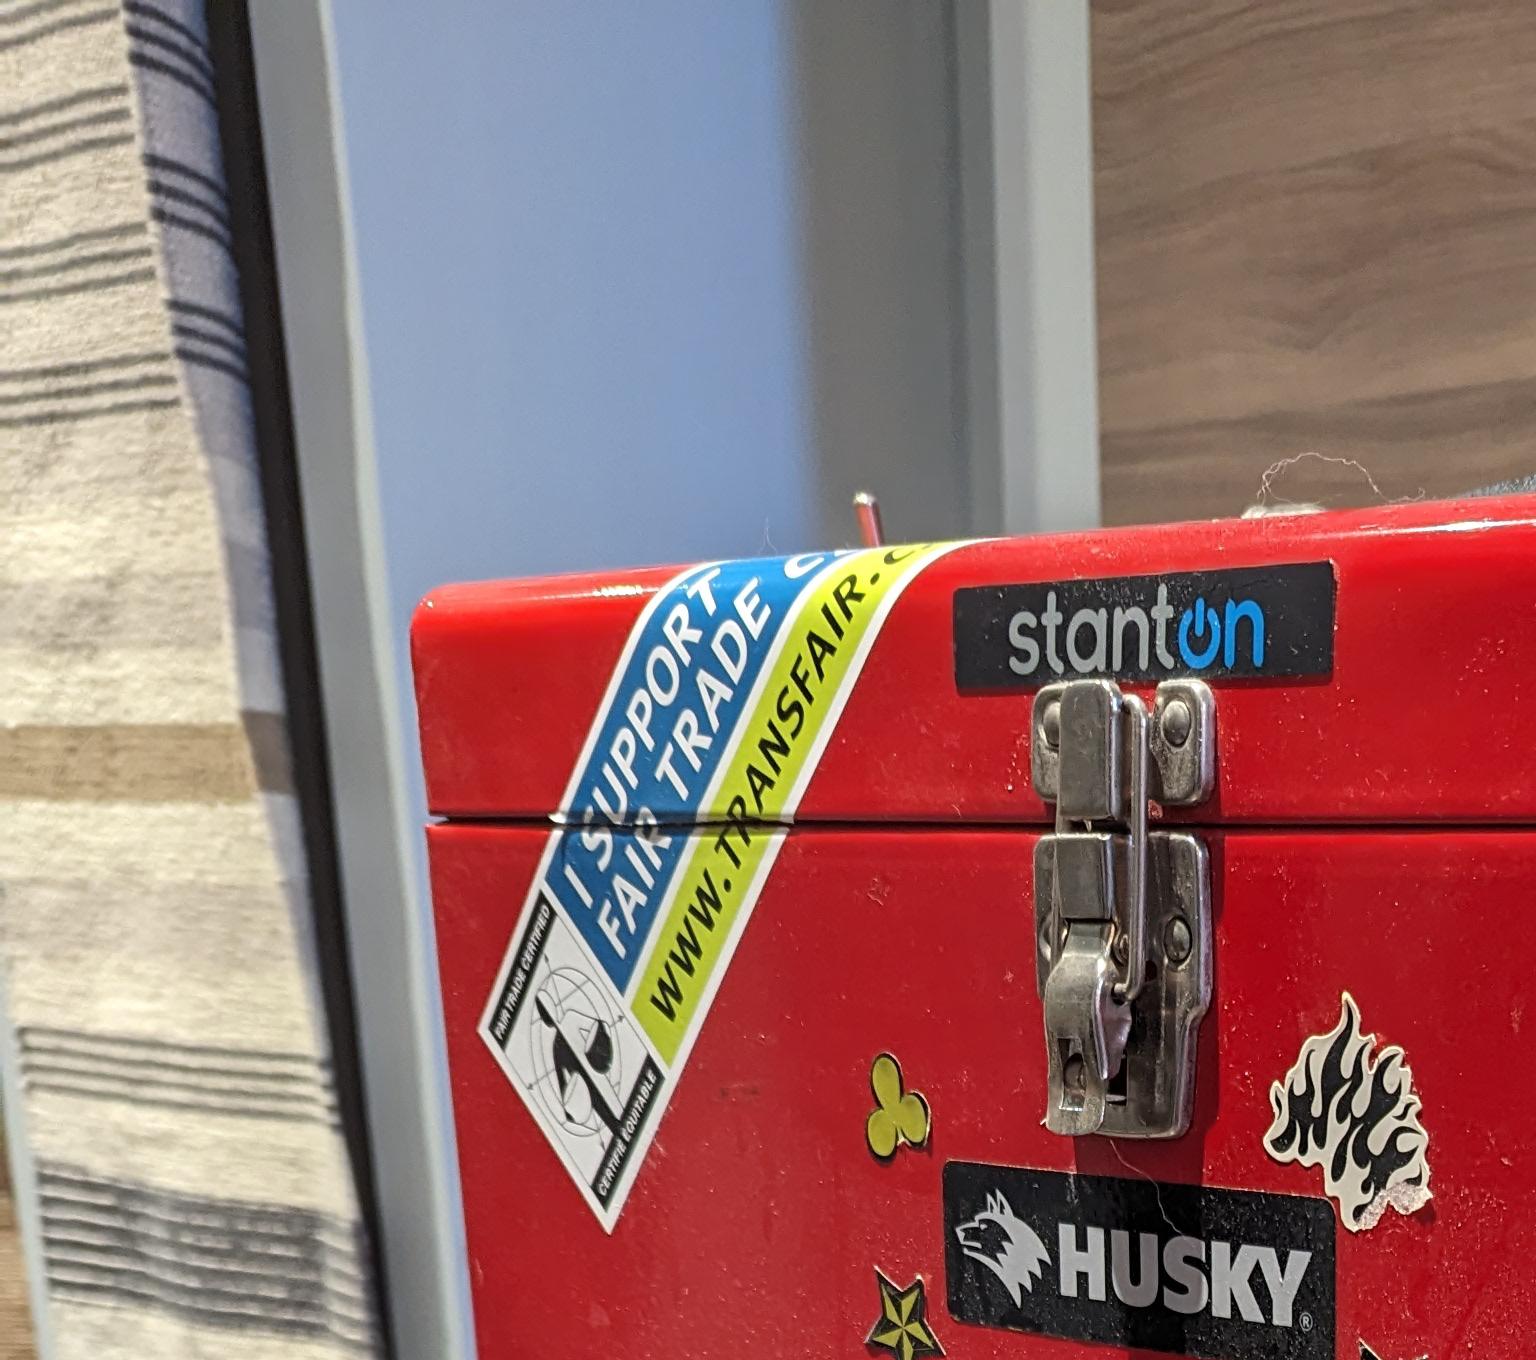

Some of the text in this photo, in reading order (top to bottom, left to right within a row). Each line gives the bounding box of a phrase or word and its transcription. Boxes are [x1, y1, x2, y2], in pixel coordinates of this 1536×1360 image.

[563, 567, 721, 909] I SUPPORT
[1007, 584, 1265, 678] stanton
[597, 806, 672, 960] FAIR
[655, 576, 771, 801] TRADE
[494, 904, 550, 1041] FAIR TRADE CERTIFIED
